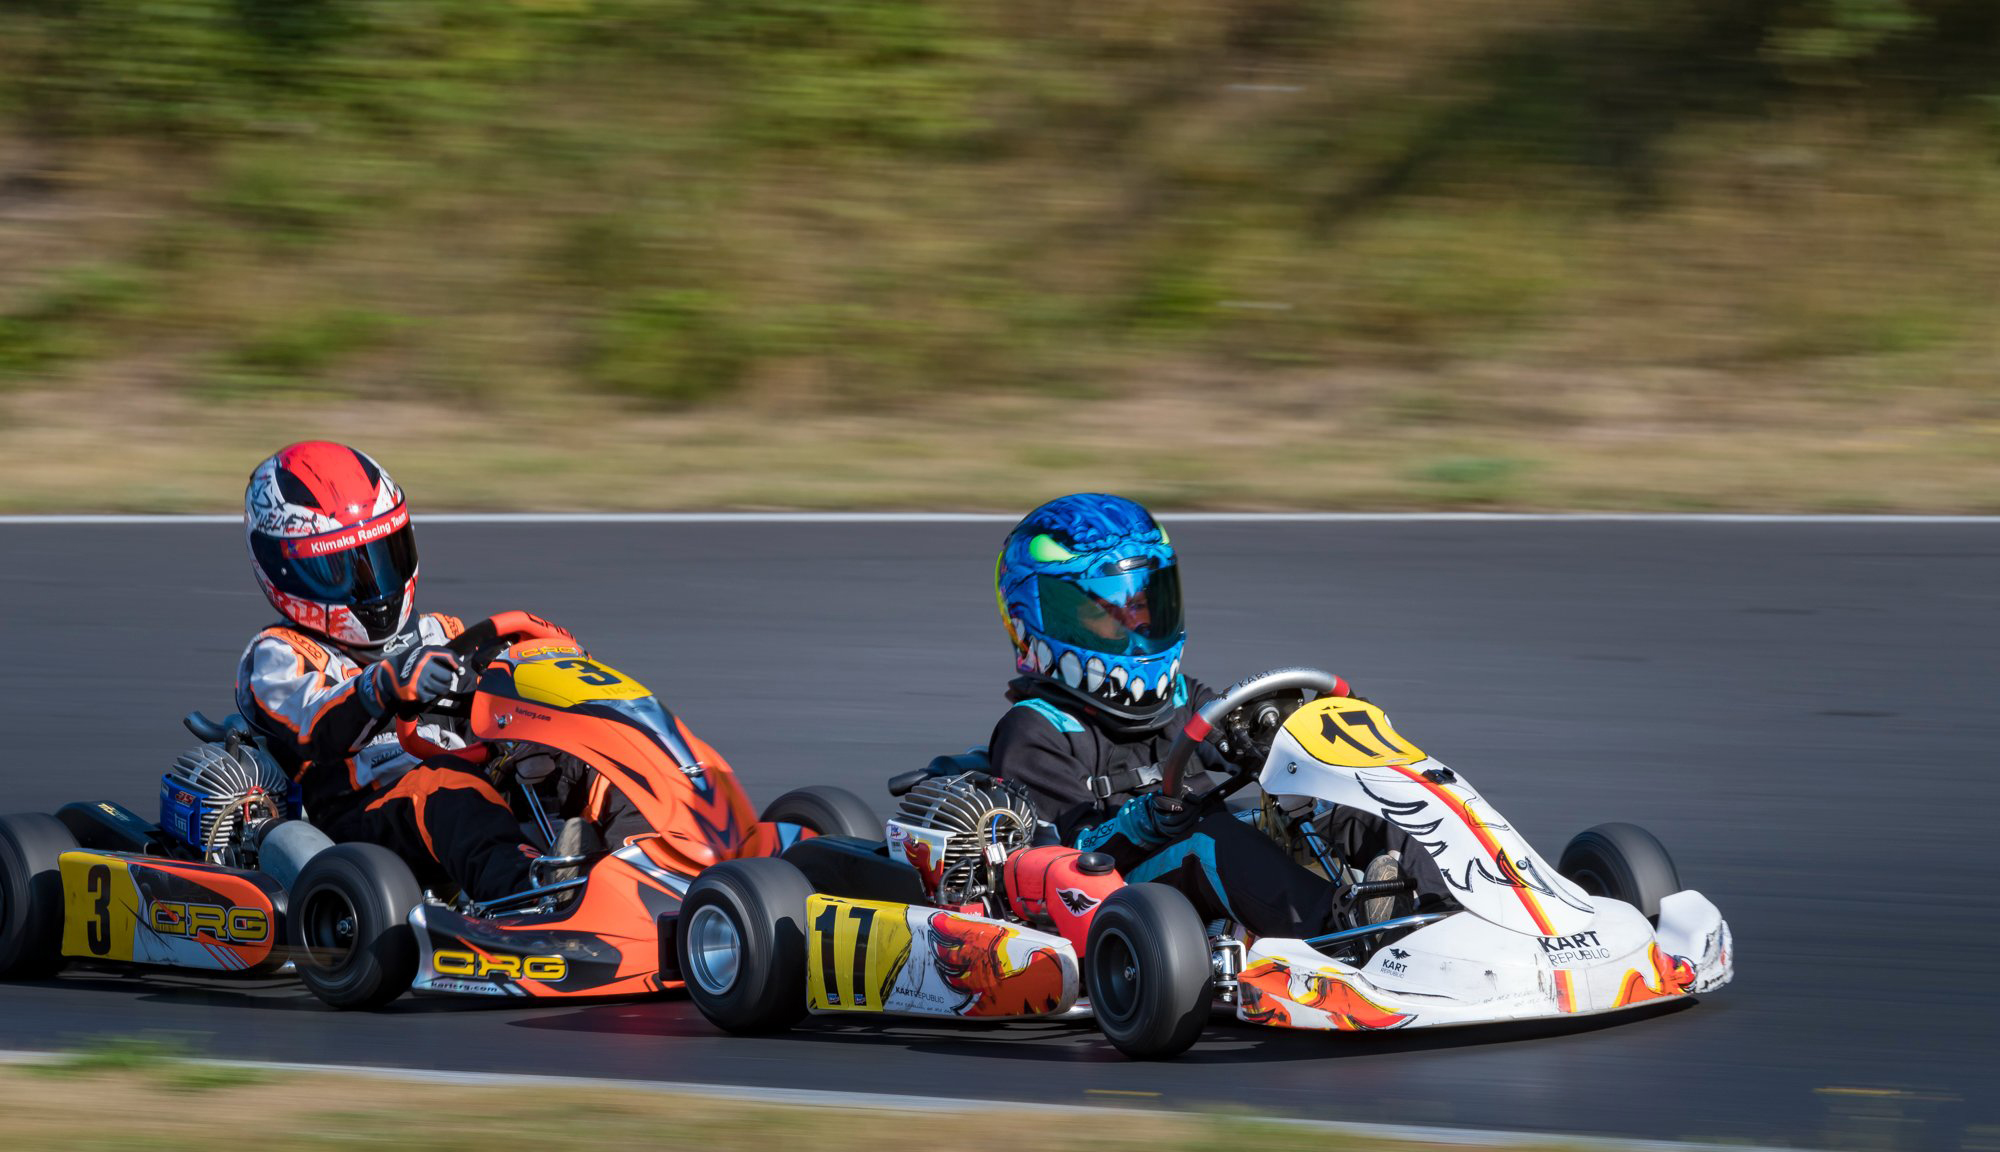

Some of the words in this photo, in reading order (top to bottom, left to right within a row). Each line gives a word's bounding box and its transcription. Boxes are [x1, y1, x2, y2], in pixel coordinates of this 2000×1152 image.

[310, 535, 356, 554] Klimaks
[357, 522, 391, 542] Racing
[554, 660, 622, 686] 3
[1320, 710, 1410, 759] 17
[87, 864, 111, 955] 3
[150, 900, 270, 943] CRG
[815, 904, 878, 1006] 17
[1537, 930, 1601, 953] KART
[1549, 947, 1611, 967] REPUBLIC
[433, 950, 568, 982] CRG
[1382, 958, 1408, 973] KART
